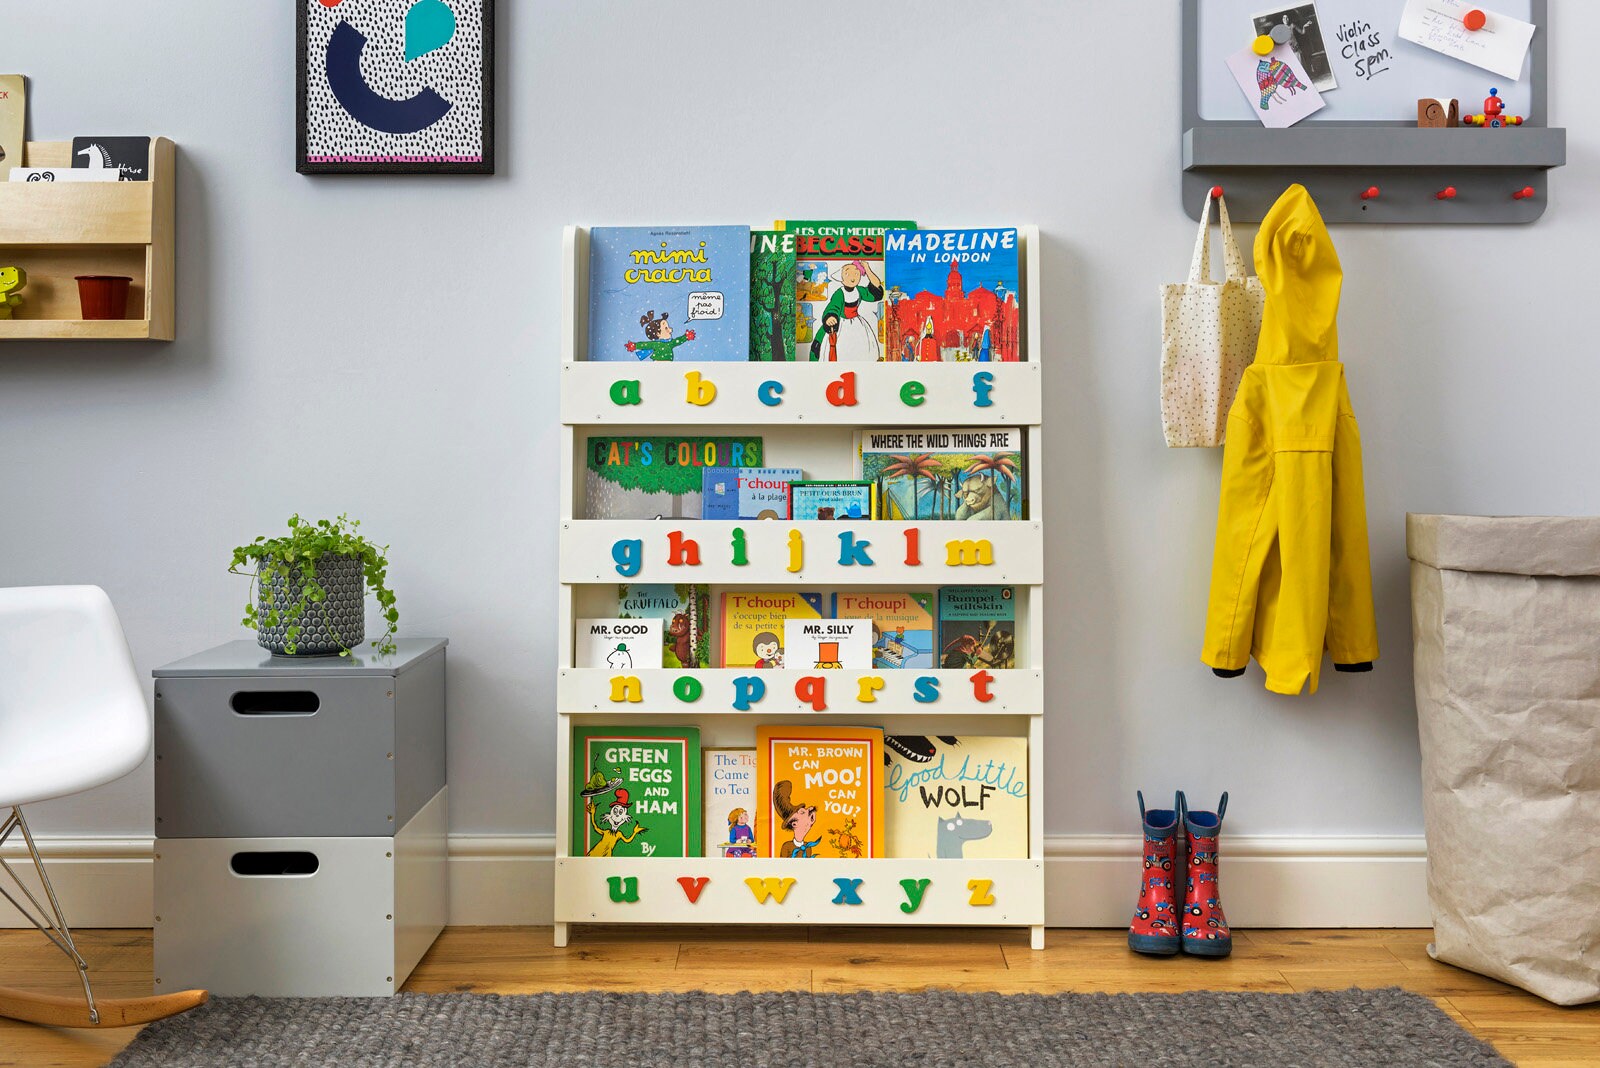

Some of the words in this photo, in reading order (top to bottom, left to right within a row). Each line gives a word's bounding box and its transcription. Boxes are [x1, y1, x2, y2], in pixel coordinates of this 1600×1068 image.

[1336, 20, 1371, 42] Violin
[1341, 32, 1380, 59] Class
[796, 227, 815, 236] LES
[818, 227, 845, 236] CENT
[886, 229, 1016, 252] MADELINE
[629, 241, 709, 264] mimi
[910, 252, 921, 263] IN
[934, 252, 991, 263] LONDON
[624, 267, 713, 284] cracra
[610, 380, 642, 406] a
[685, 371, 717, 406] b
[758, 380, 783, 406] c
[826, 371, 858, 407] d
[900, 381, 925, 407] e
[972, 371, 994, 407] f
[871, 434, 903, 449] WHERE
[906, 434, 924, 448] THE
[926, 434, 949, 448] WILD
[952, 433, 987, 448] THINGS
[990, 433, 1009, 448] ARE
[594, 441, 653, 467] CAT'S
[664, 441, 758, 467] COLOURS
[767, 493, 787, 502] plage
[612, 539, 642, 577] g
[667, 531, 700, 566] h
[731, 527, 748, 566] i
[787, 529, 803, 573] j
[838, 531, 874, 566] k
[945, 539, 994, 566] m
[624, 598, 679, 610] GRUFFALO
[732, 596, 796, 612] T'choupi
[843, 597, 906, 614] T'choupi
[733, 612, 767, 621] s'occupe
[886, 614, 919, 623] musique
[590, 625, 611, 635] MR.
[613, 625, 648, 635] GOOD
[733, 621, 743, 629] de
[755, 622, 778, 631] petite
[803, 625, 824, 634] MR.
[826, 625, 854, 634] SILLY
[609, 675, 643, 703] n
[673, 676, 703, 703] o
[732, 676, 766, 711] p
[795, 676, 827, 711] q
[857, 676, 885, 703] r
[913, 676, 940, 703] s
[970, 670, 994, 703] t
[605, 747, 669, 764] GREEN
[714, 754, 737, 766] The
[788, 746, 812, 757] MR.
[817, 747, 863, 758] BROWN
[793, 759, 819, 771] CAN
[629, 767, 673, 783] EGGS
[714, 769, 749, 780] Came
[804, 766, 862, 789] MOO!
[957, 754, 1027, 798] Little
[644, 787, 670, 797] AND
[714, 787, 727, 795] to
[728, 783, 749, 795] Tea
[828, 789, 857, 800] CAN
[919, 784, 996, 811] WOLF
[635, 800, 678, 815] HAM
[824, 800, 861, 818] YOU?
[640, 842, 657, 856] By
[606, 876, 640, 903] u
[676, 876, 710, 904] v
[744, 877, 797, 904] w
[831, 878, 863, 905] x
[899, 878, 931, 913] y
[967, 879, 995, 906] z
